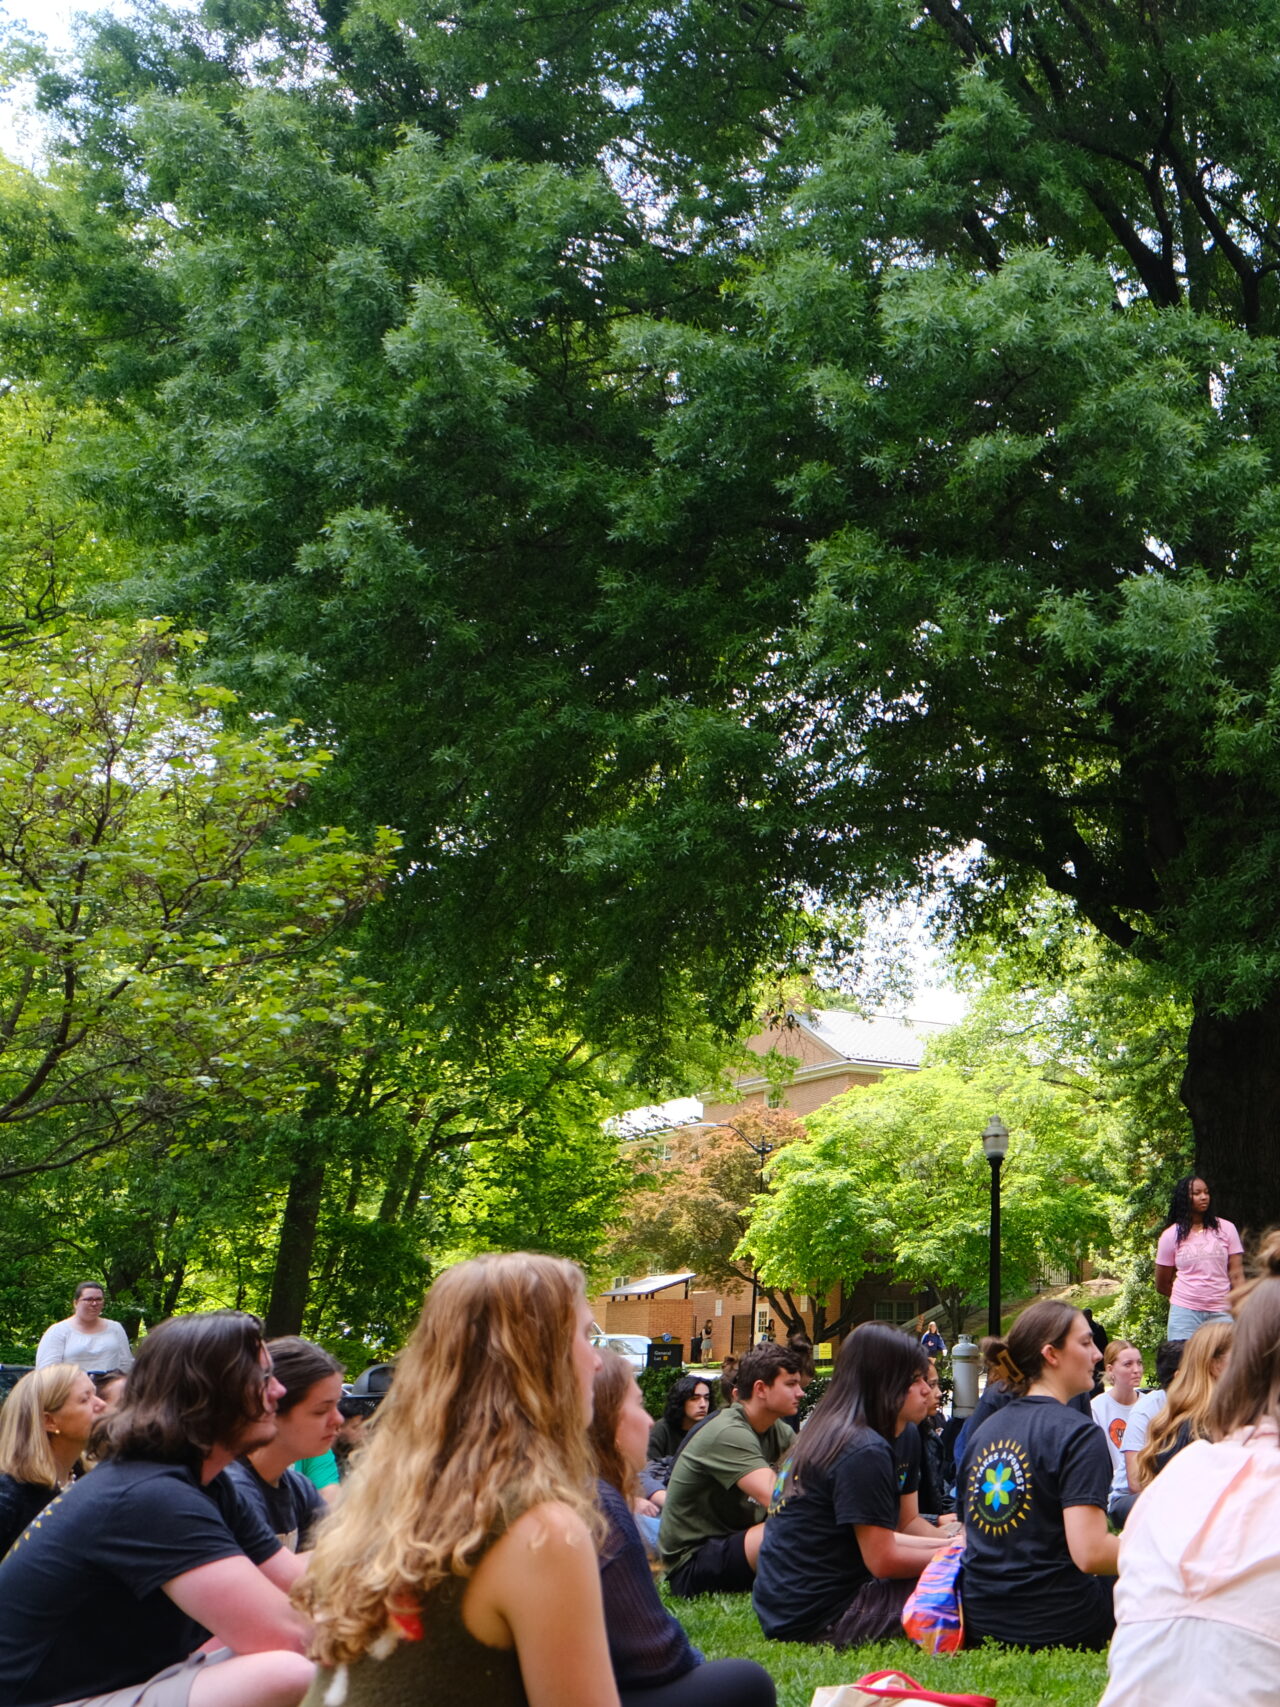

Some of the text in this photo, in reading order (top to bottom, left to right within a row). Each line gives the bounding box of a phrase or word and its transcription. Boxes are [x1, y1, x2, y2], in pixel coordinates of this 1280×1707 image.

[973, 1451, 1025, 1494] IT TAKES A FOREST
